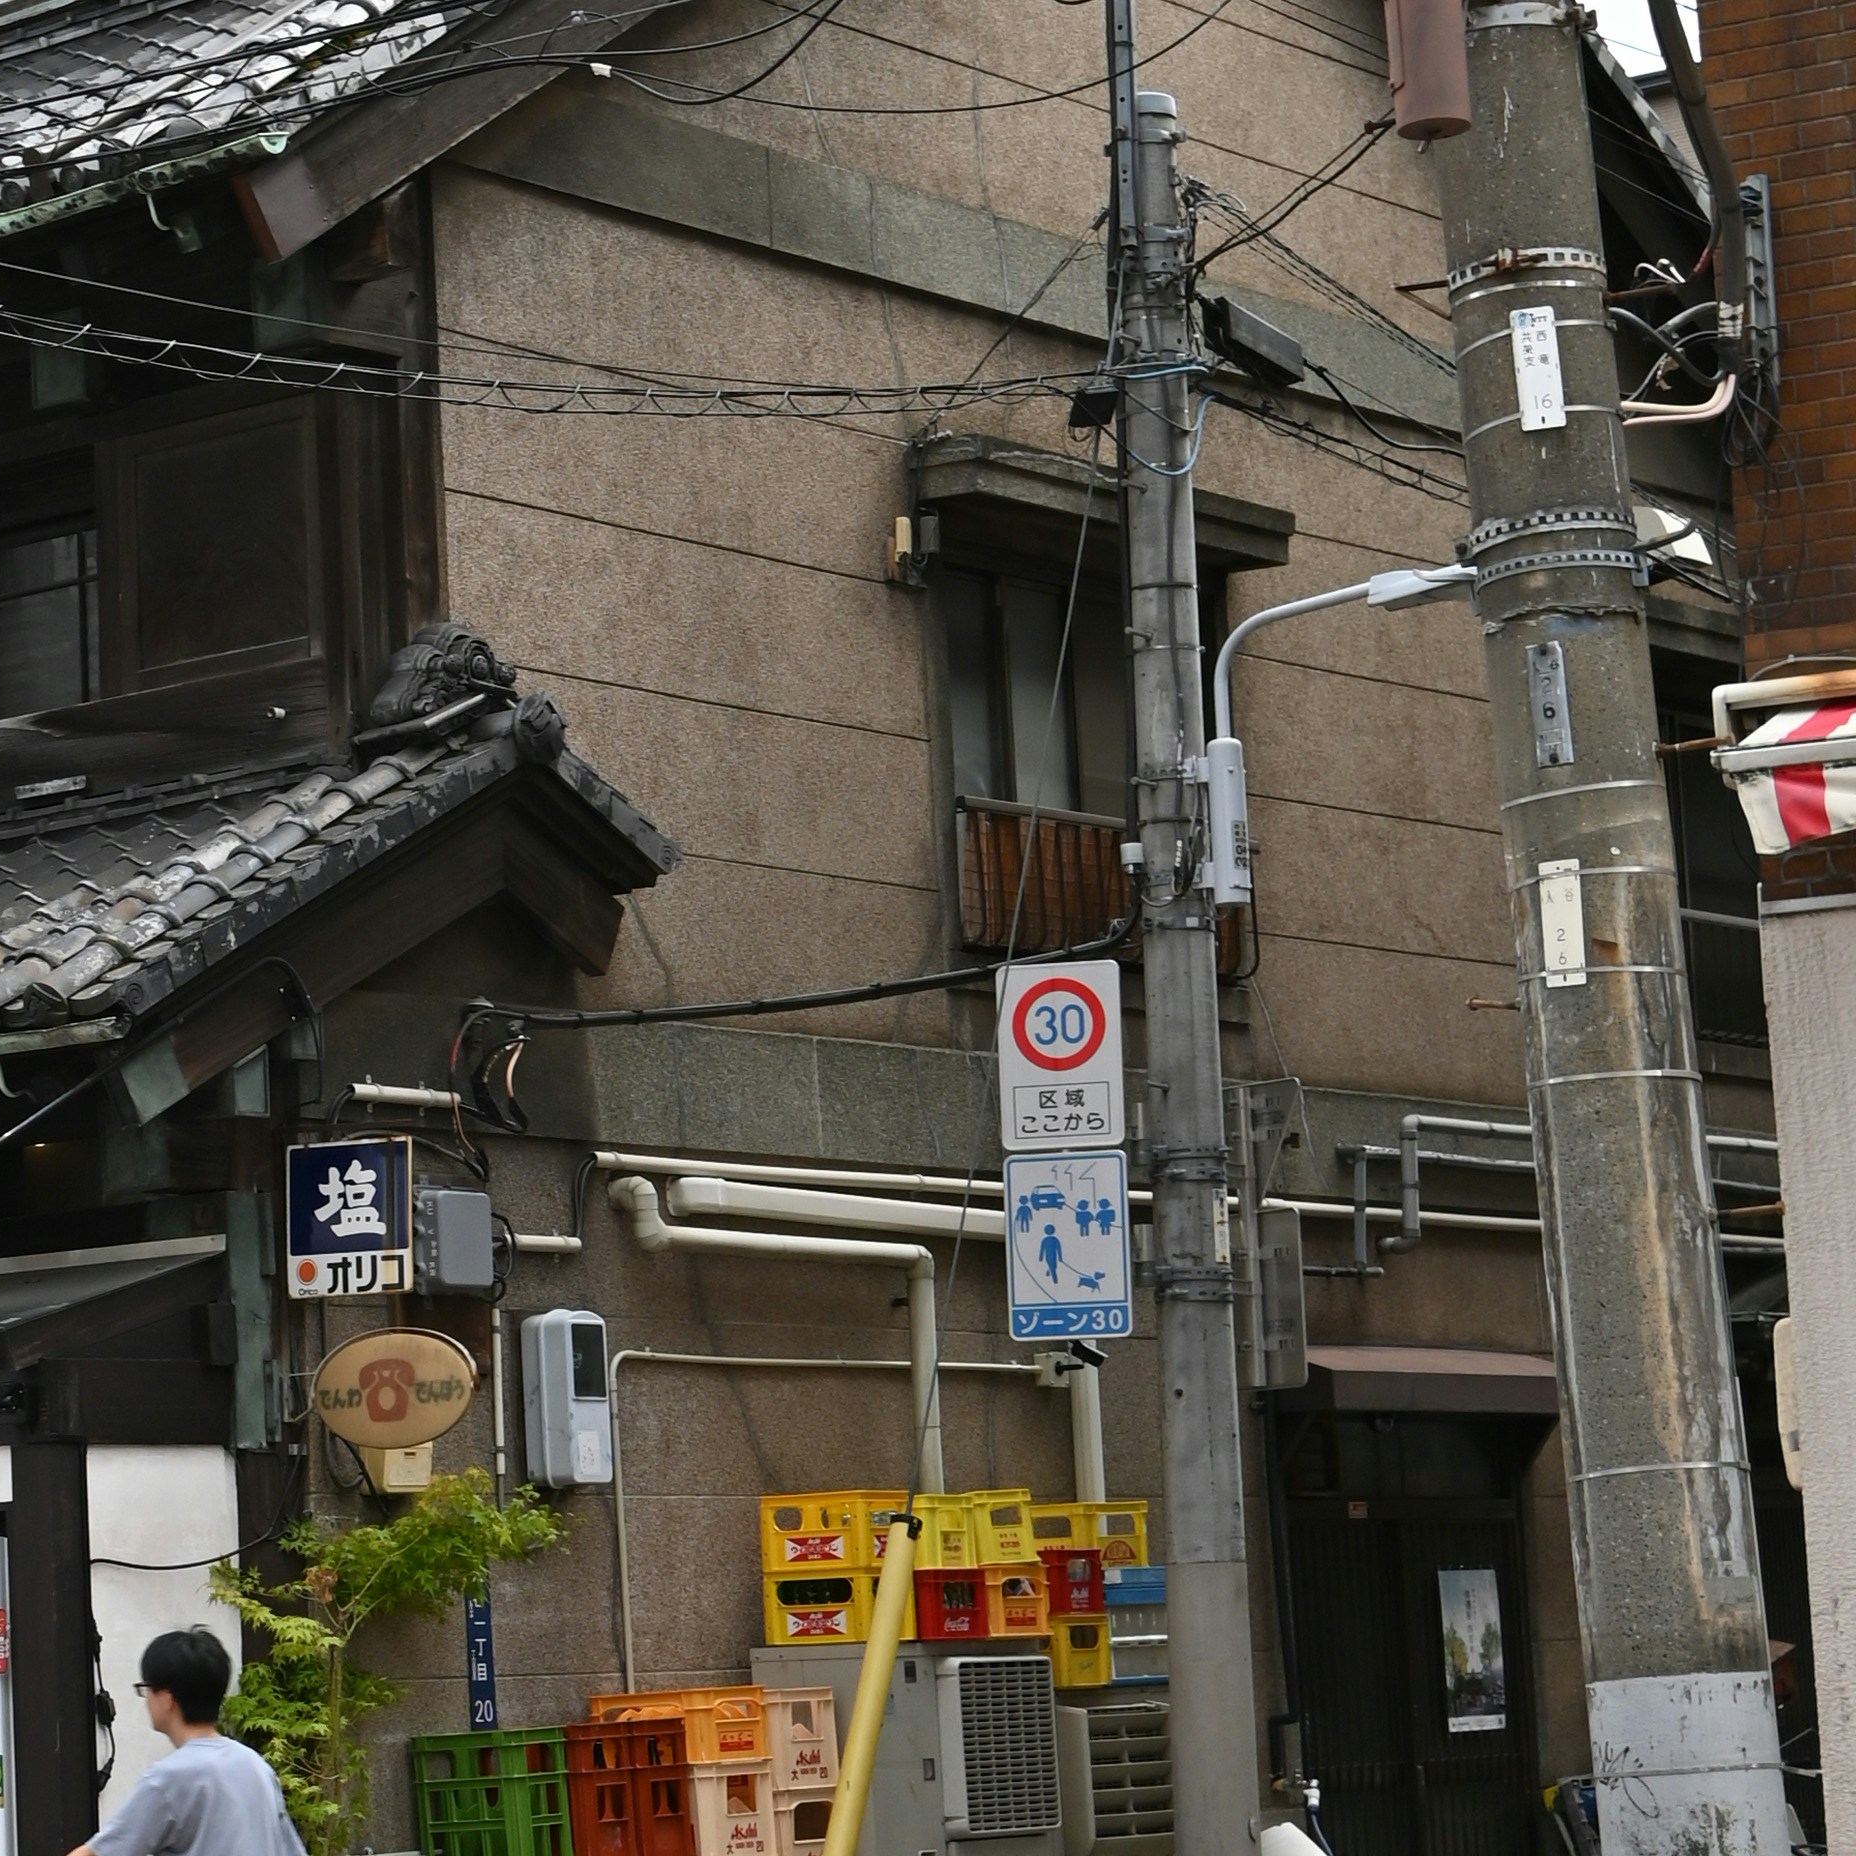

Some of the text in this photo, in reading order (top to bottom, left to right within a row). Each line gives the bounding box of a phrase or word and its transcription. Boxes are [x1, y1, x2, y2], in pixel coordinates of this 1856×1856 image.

[1534, 393, 1553, 410] 16
[1035, 1004, 1086, 1045] 30
[1039, 1089, 1086, 1110] 区域
[1021, 1112, 1106, 1134] ここから
[313, 1159, 387, 1238] 塩
[326, 1255, 405, 1294] オリコ
[1018, 1309, 1124, 1335] ゾーン30
[319, 1387, 363, 1411] でんわ
[475, 1699, 494, 1723] 20
[796, 1748, 821, 1766] Asahi
[731, 1823, 757, 1841] Asahi
